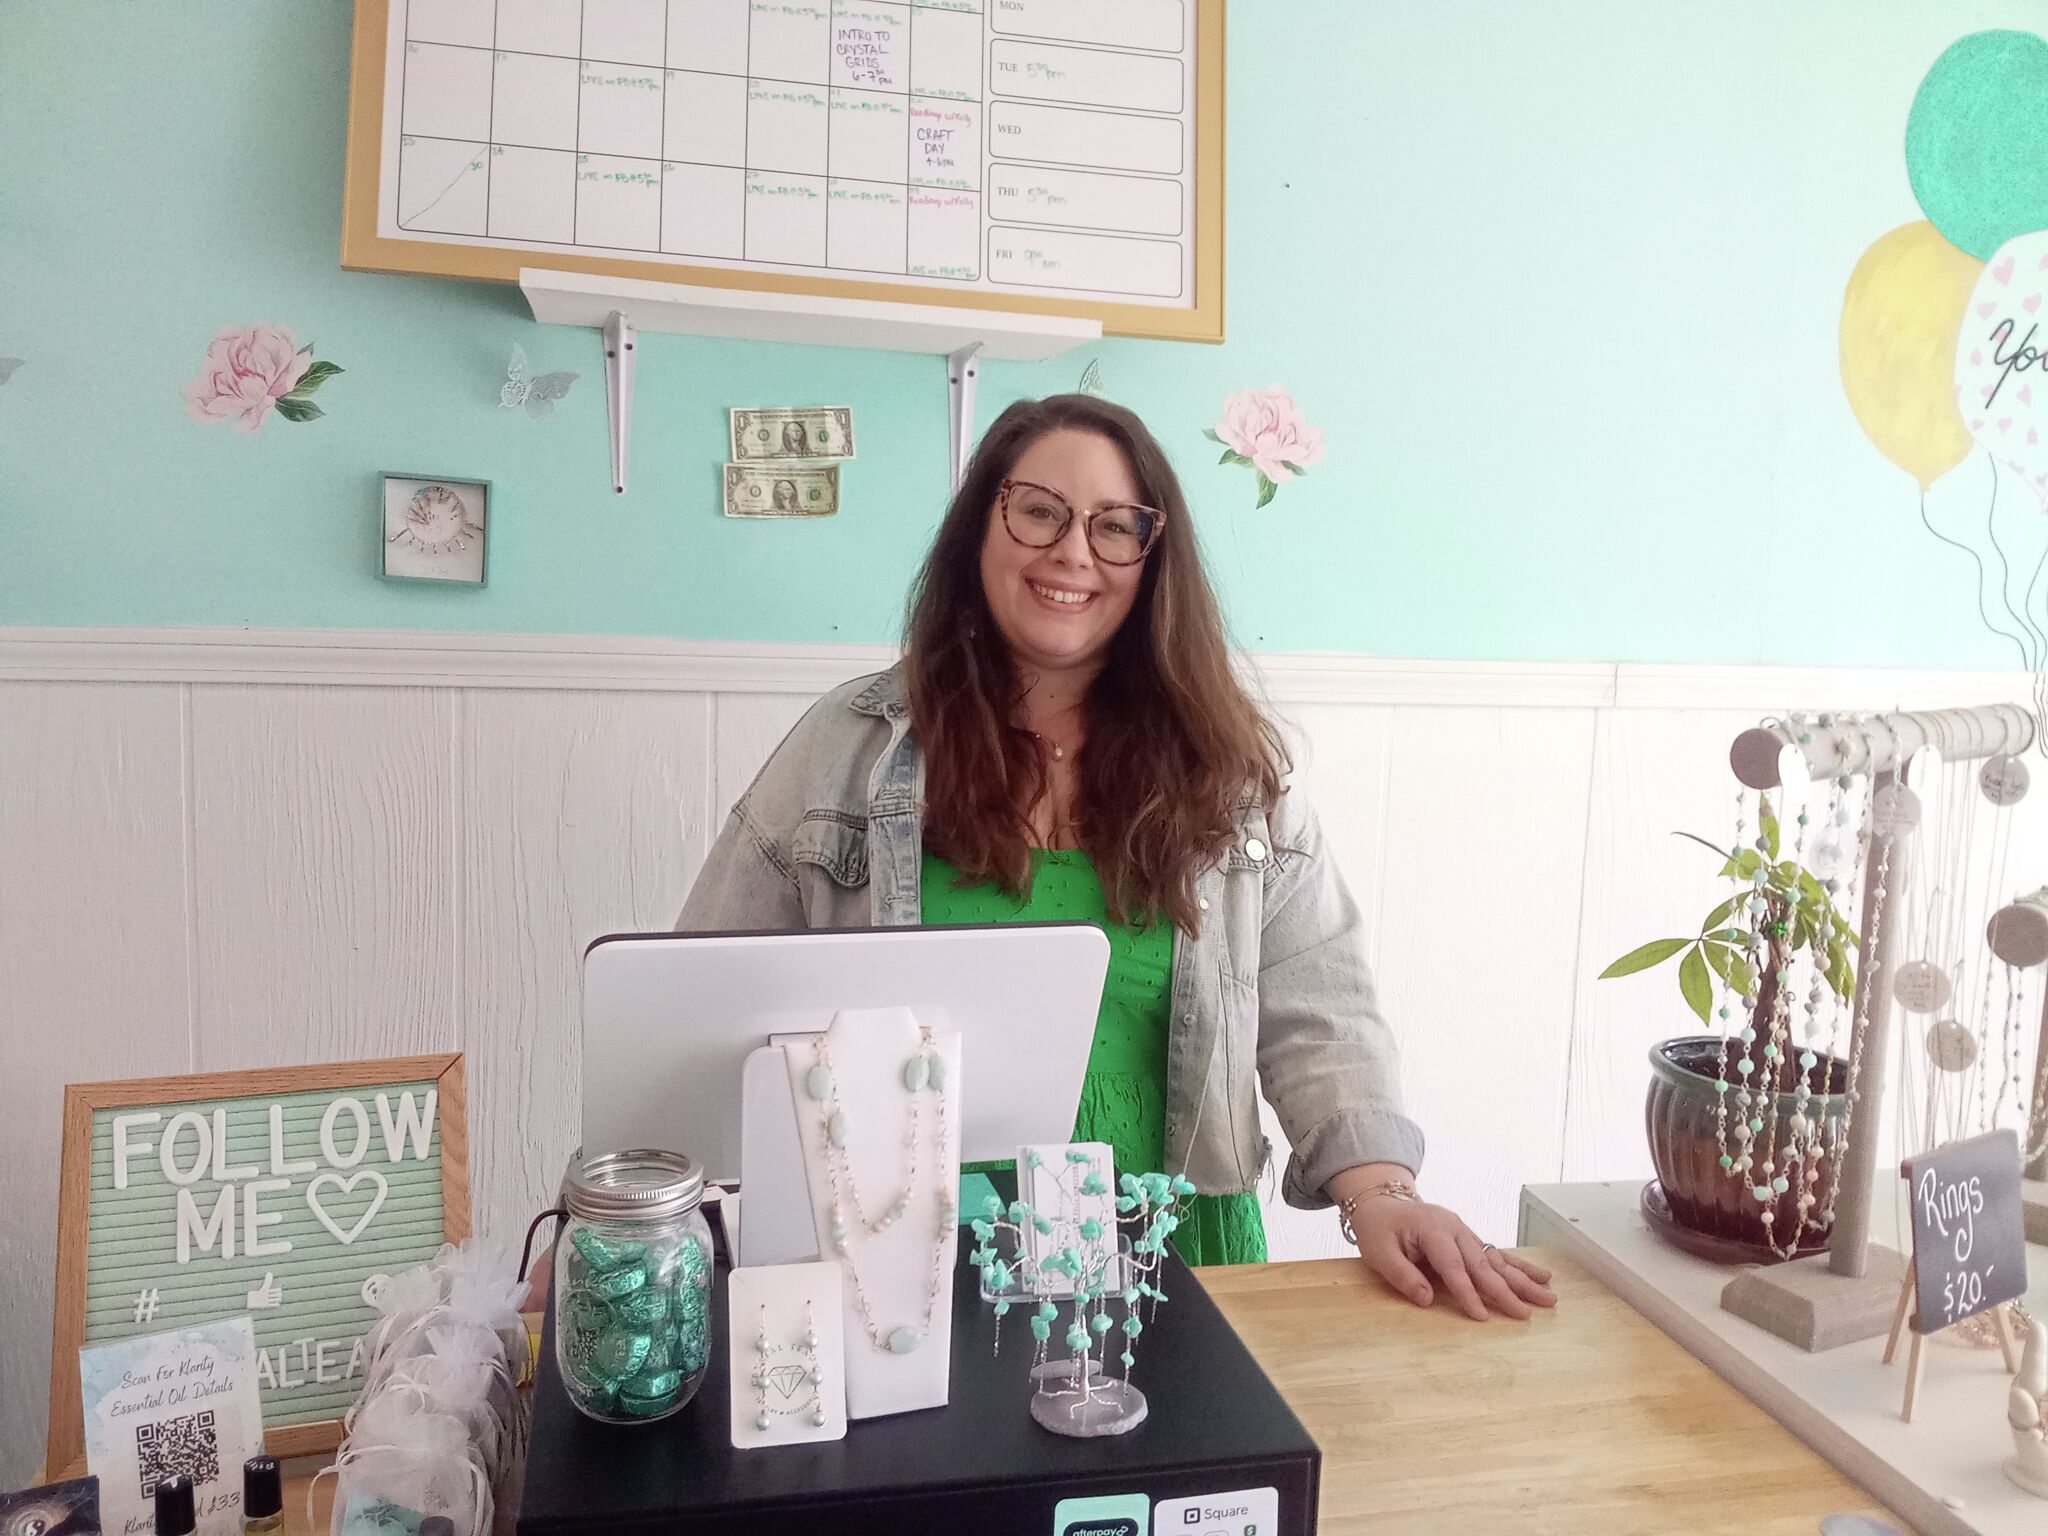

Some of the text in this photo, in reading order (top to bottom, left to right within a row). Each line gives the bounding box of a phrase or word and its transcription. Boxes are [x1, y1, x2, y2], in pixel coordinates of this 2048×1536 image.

[999, 0, 1024, 11] MON
[838, 29, 890, 41] INTRO TO
[837, 43, 889, 55] CRYSTAL
[845, 56, 879, 69] GRIDS
[998, 62, 1019, 72] TUE
[917, 128, 955, 141] CRAFT
[997, 124, 1022, 135] WED
[924, 142, 945, 155] DAY
[996, 186, 1019, 197] THU
[996, 249, 1012, 260] FRI
[112, 1089, 438, 1190] FOLLOW
[1918, 1167, 1984, 1262] Rings
[176, 1178, 293, 1265] ME
[121, 1355, 215, 1390] Scan For Klarity
[110, 1376, 233, 1418] Essential Oil Details
[207, 1491, 240, 1514] $33
[1203, 1504, 1249, 1521] Square
